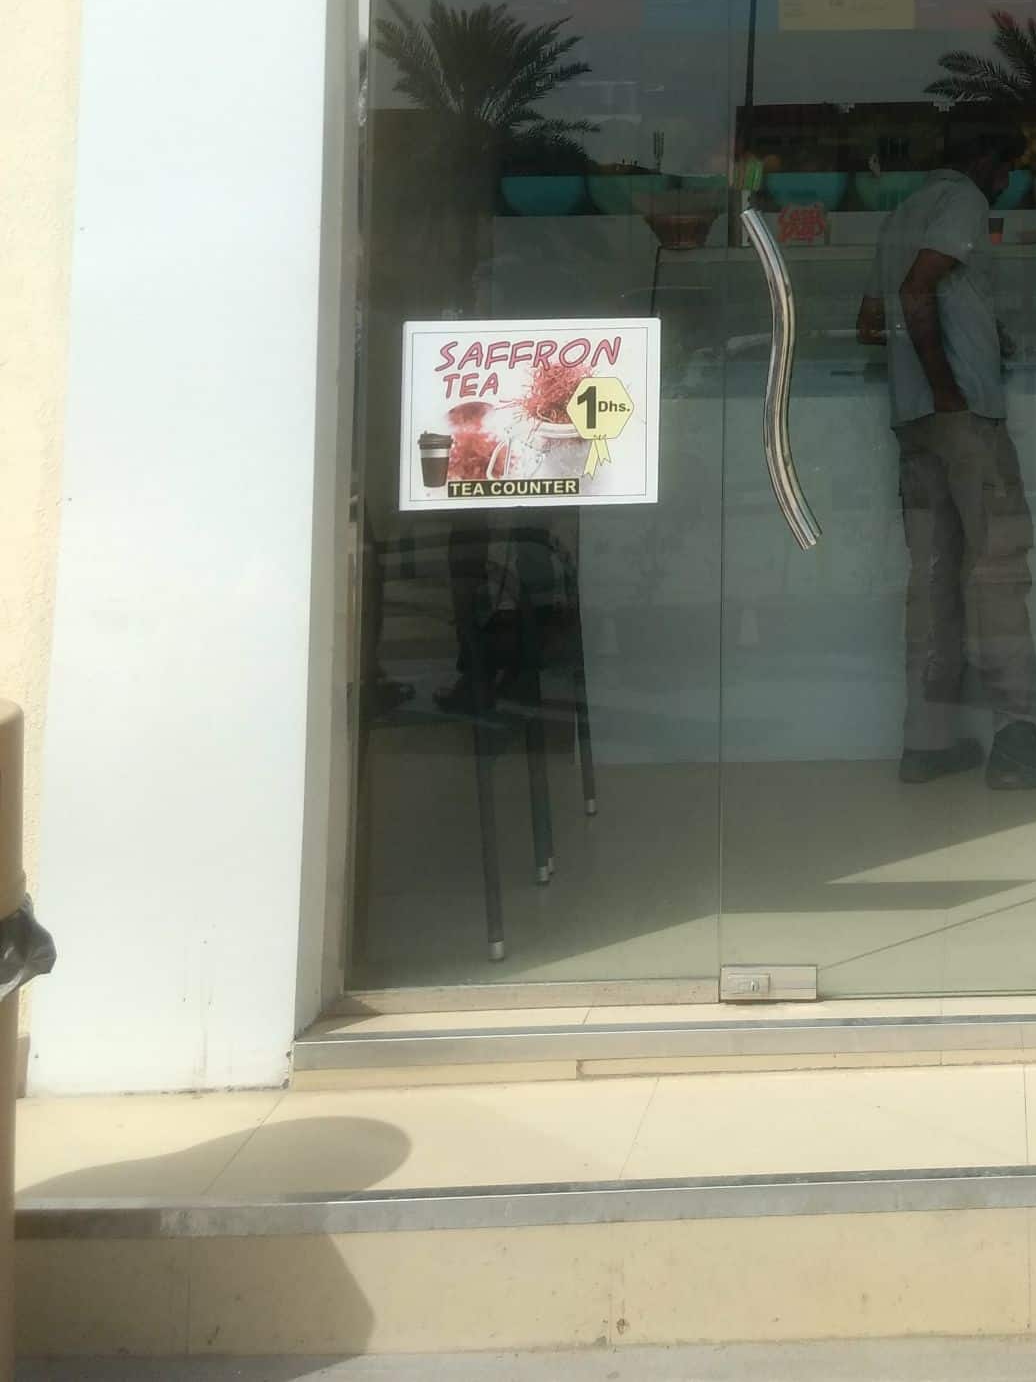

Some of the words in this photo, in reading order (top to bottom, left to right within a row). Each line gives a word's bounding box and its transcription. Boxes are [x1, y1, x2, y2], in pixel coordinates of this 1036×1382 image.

[434, 336, 622, 372] SAFFRON
[443, 371, 500, 399] TEA
[576, 385, 597, 430] 1
[598, 399, 631, 413] Dhs.
[450, 482, 485, 497] TEA
[490, 480, 577, 496] COUNTER
